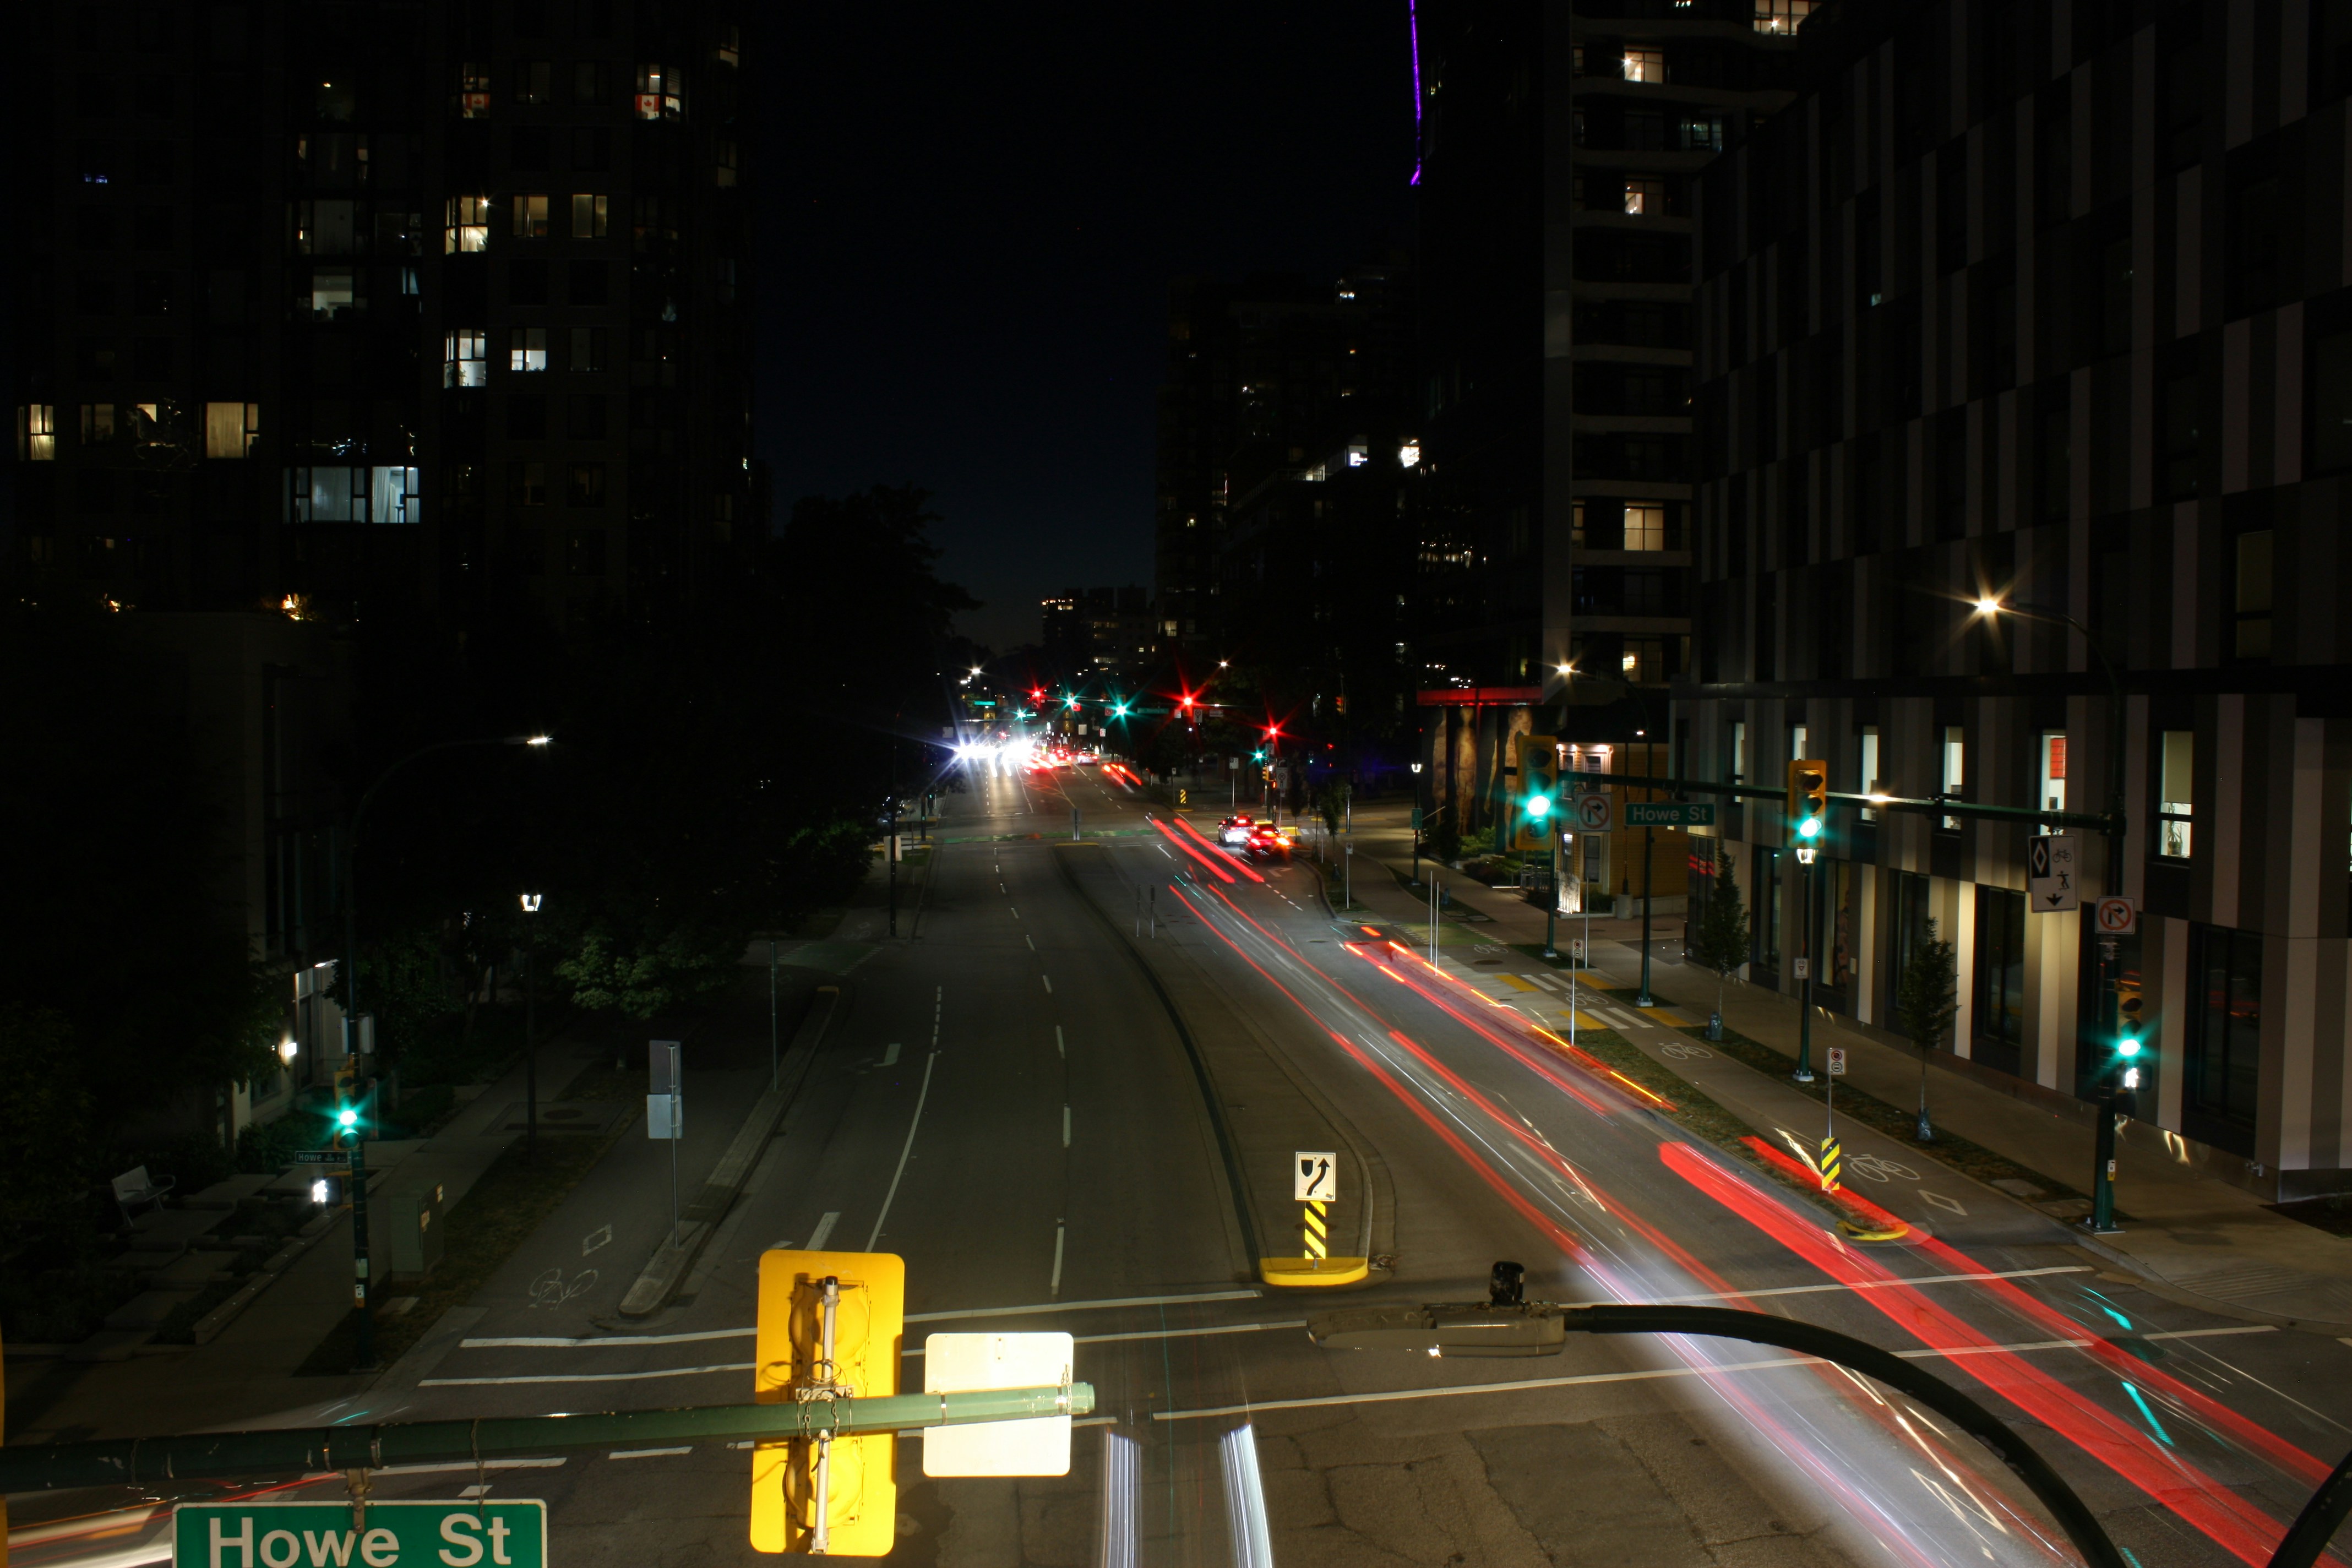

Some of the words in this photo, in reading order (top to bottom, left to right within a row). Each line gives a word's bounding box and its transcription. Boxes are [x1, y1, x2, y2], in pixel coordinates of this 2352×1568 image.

[1634, 807, 1680, 821] Howe
[1689, 807, 1706, 821] St
[210, 1517, 399, 1568] Howe
[438, 1513, 511, 1567] St
